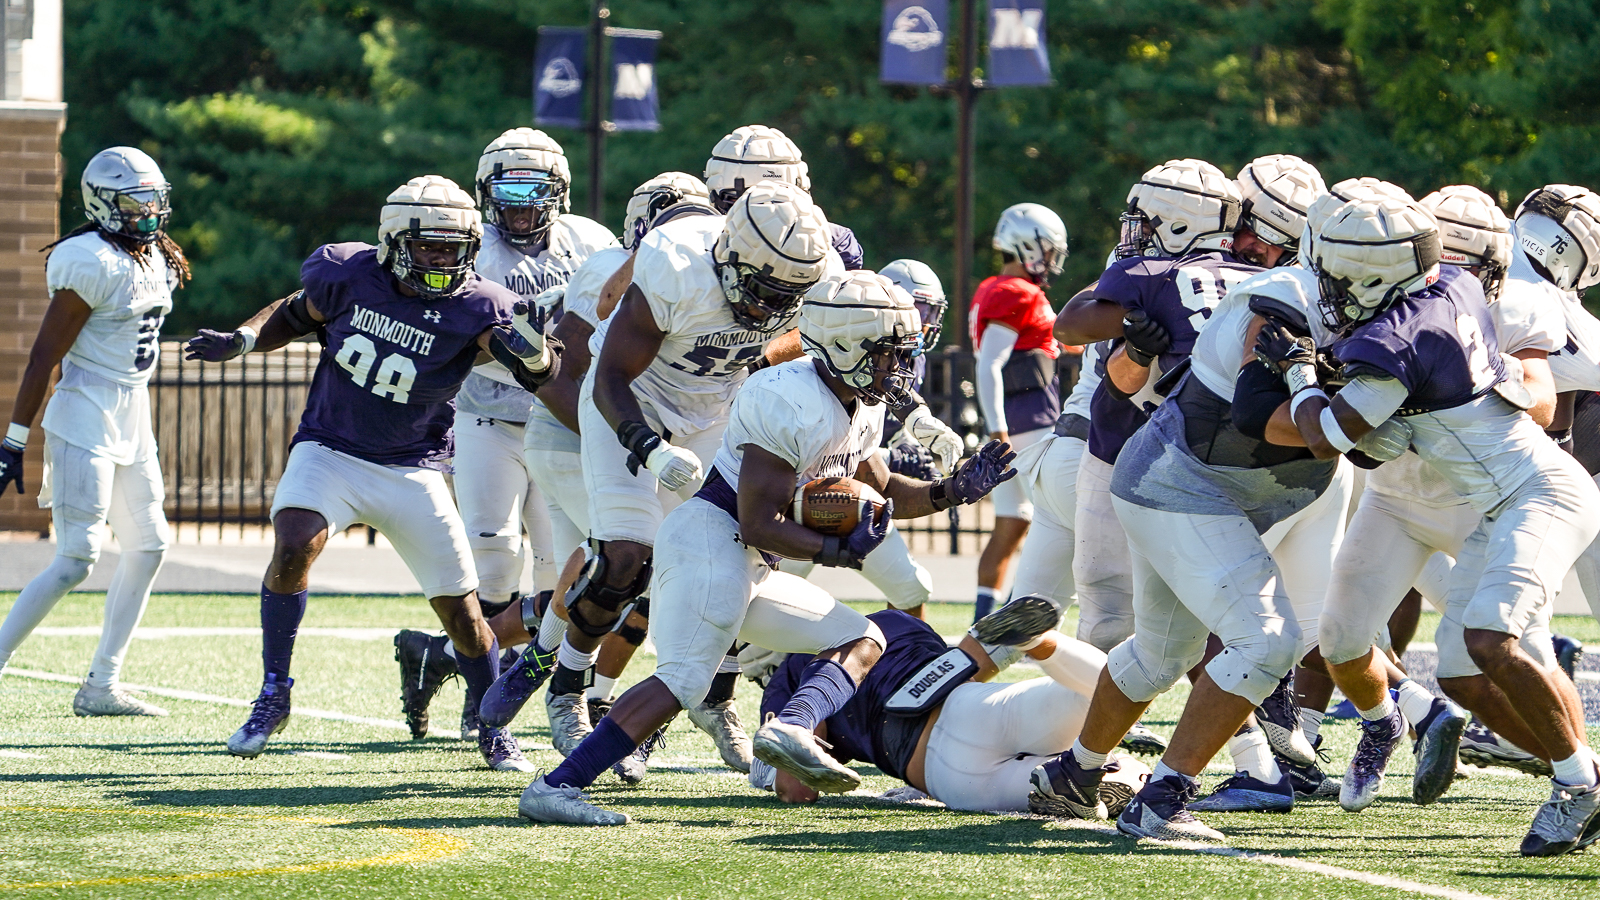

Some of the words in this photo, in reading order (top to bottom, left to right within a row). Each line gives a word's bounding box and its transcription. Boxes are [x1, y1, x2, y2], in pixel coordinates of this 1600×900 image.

[991, 8, 1043, 48] M
[614, 62, 652, 100] M
[1521, 237, 1546, 256] VICIS
[1550, 234, 1569, 255] 76
[349, 304, 436, 356] MONMOUTH
[334, 333, 418, 404] 98
[811, 510, 844, 519] Wilson
[907, 660, 955, 699] DOUGLAS
